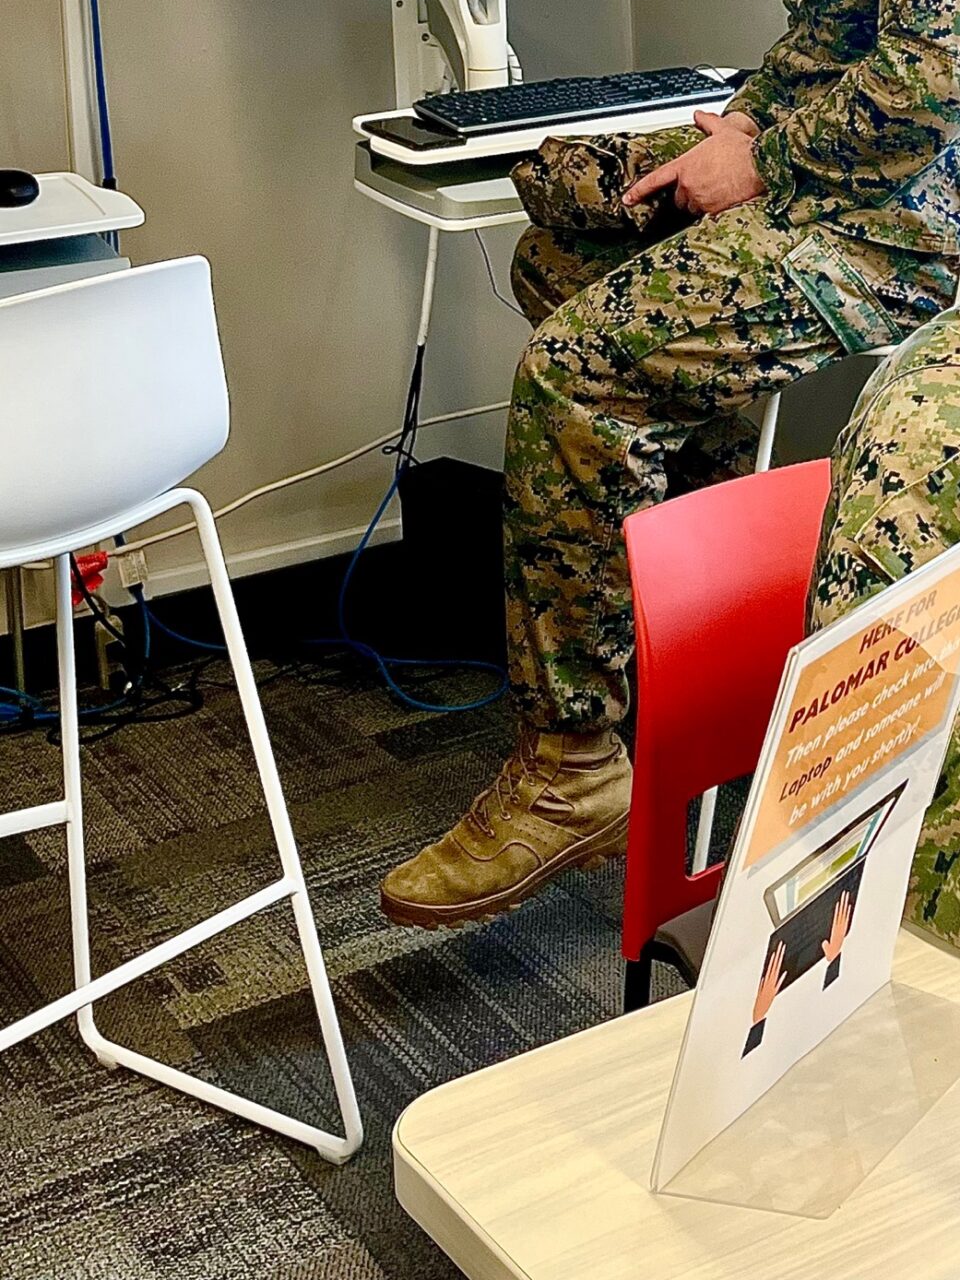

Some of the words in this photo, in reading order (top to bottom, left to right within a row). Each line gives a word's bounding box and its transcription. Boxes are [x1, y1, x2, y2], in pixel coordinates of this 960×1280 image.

[859, 613, 901, 654] HERE
[905, 590, 938, 625] FOR
[779, 756, 832, 803] Laptop
[835, 731, 865, 762] and
[864, 693, 921, 742] someone
[924, 670, 948, 699] will
[785, 734, 823, 768] Then
[822, 701, 870, 750] please
[872, 670, 911, 709] check
[789, 650, 890, 734] PALOMAR
[788, 802, 808, 827] be
[811, 777, 842, 809] with
[842, 758, 871, 792] you
[871, 714, 922, 764] shortly!
